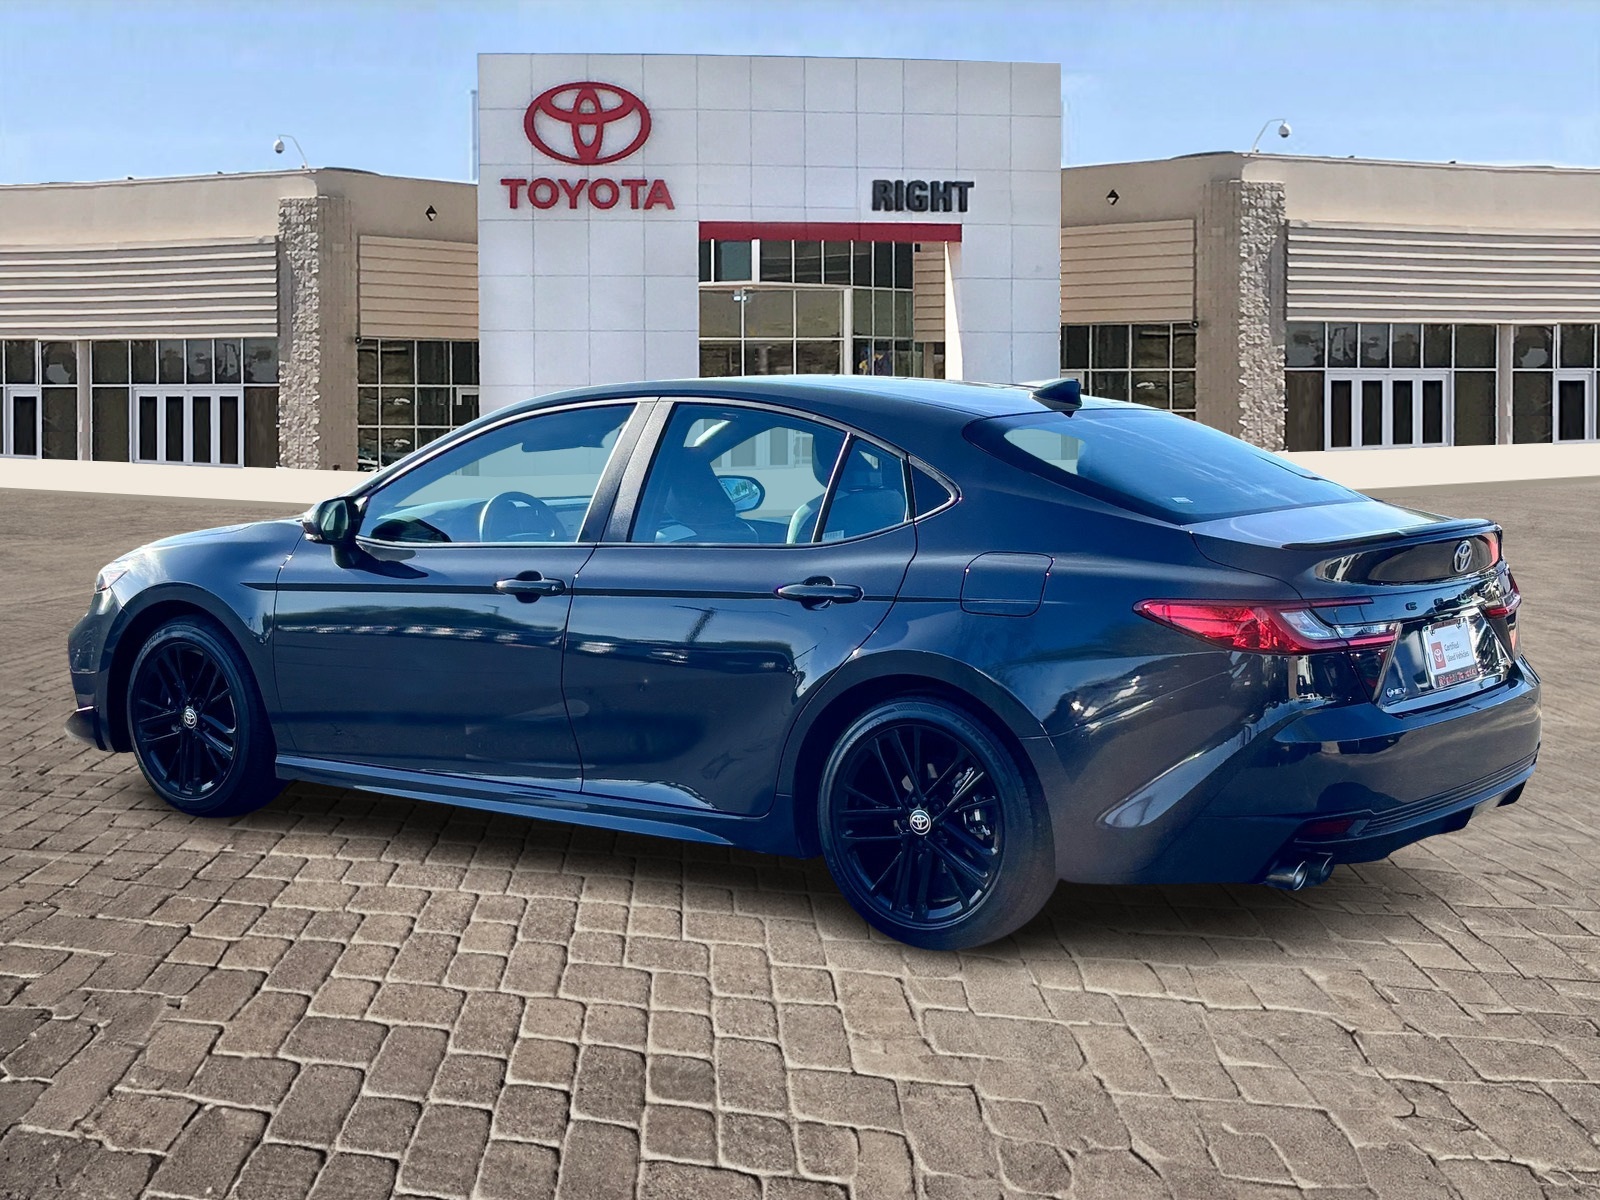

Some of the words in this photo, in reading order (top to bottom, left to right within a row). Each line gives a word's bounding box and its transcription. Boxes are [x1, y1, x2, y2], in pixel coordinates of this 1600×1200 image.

[500, 177, 676, 210] TOYOTA
[871, 179, 975, 213] RIGHT
[1444, 641, 1459, 651] Certified
